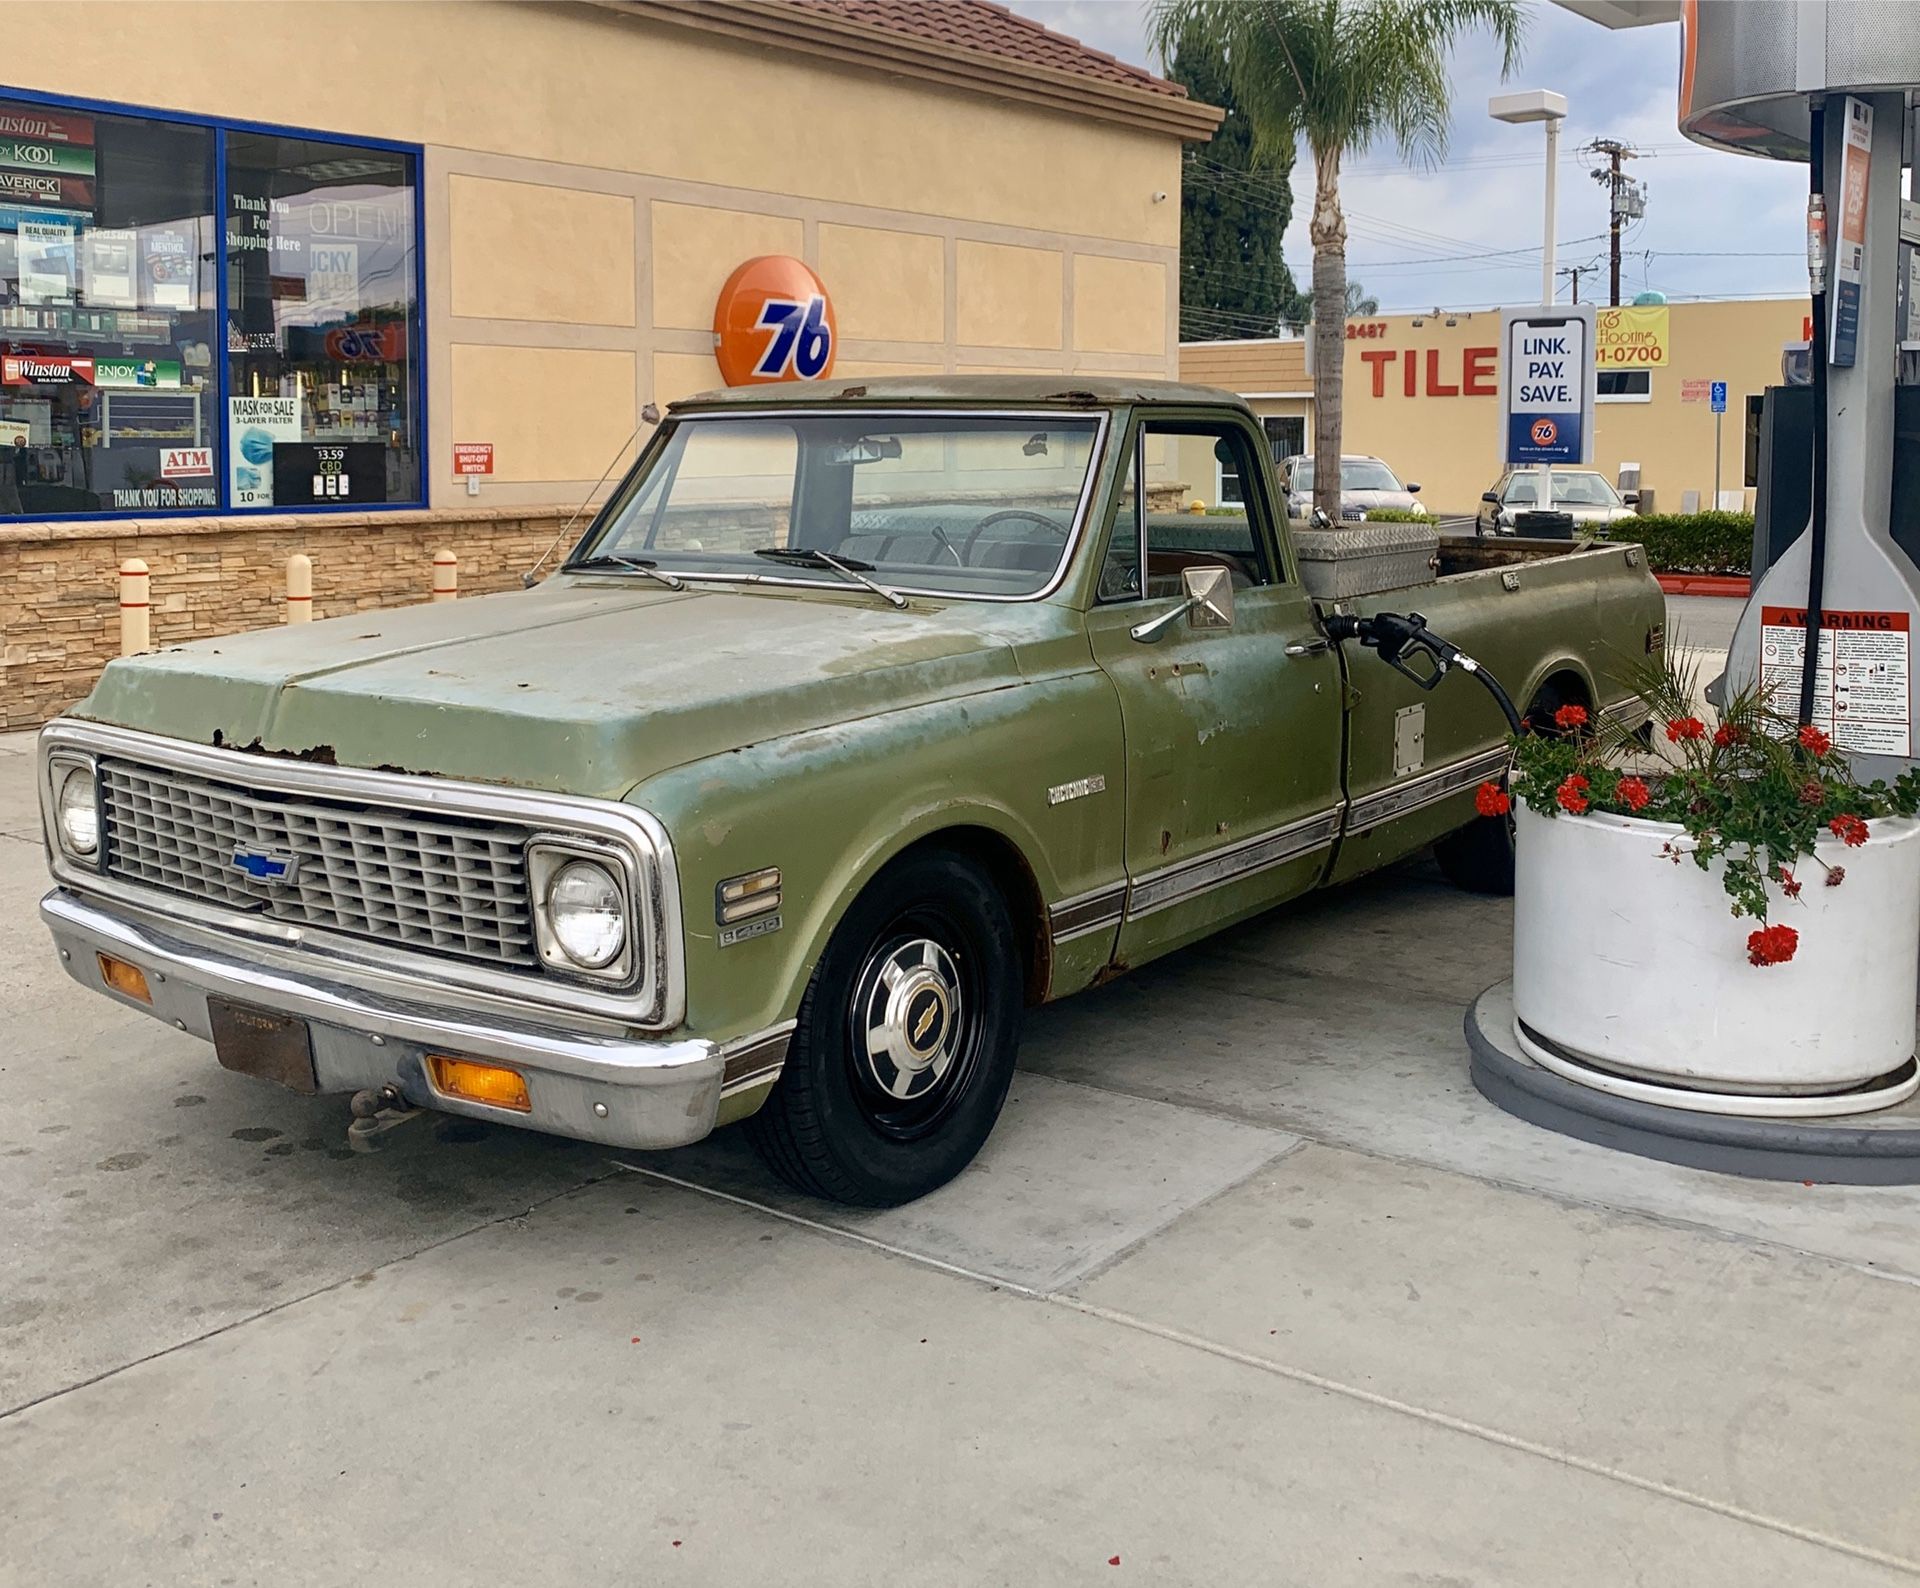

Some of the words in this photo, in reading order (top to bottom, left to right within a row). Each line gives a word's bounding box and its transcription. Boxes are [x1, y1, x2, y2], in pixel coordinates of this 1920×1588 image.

[14, 144, 60, 165] KOOL
[233, 194, 268, 213] Thank
[268, 198, 290, 214] You
[253, 215, 272, 230] For
[309, 202, 399, 240] OPEN
[42, 228, 67, 237] QUALITY
[226, 231, 273, 252] Shopping
[276, 235, 301, 252] Here
[752, 293, 831, 380] 76
[1523, 338, 1571, 356] LINK.
[1595, 346, 1662, 363] 1-0700
[19, 360, 71, 377] Winston
[97, 365, 135, 379] ENJOY.
[1361, 347, 1498, 398] TILE
[1528, 362, 1564, 379] PAY.
[1520, 385, 1572, 403] SAVE.
[233, 400, 259, 416] MASK
[260, 402, 273, 414] FOR
[274, 401, 294, 416] SALE
[1534, 424, 1554, 440] 76
[166, 451, 208, 467] ATM
[318, 450, 344, 460] $3.59
[320, 461, 342, 472] CBD
[113, 490, 141, 507] THANK
[142, 489, 159, 507] YOU
[161, 488, 177, 506] FOR
[178, 488, 217, 506] SHOPPING
[240, 492, 254, 502] 10
